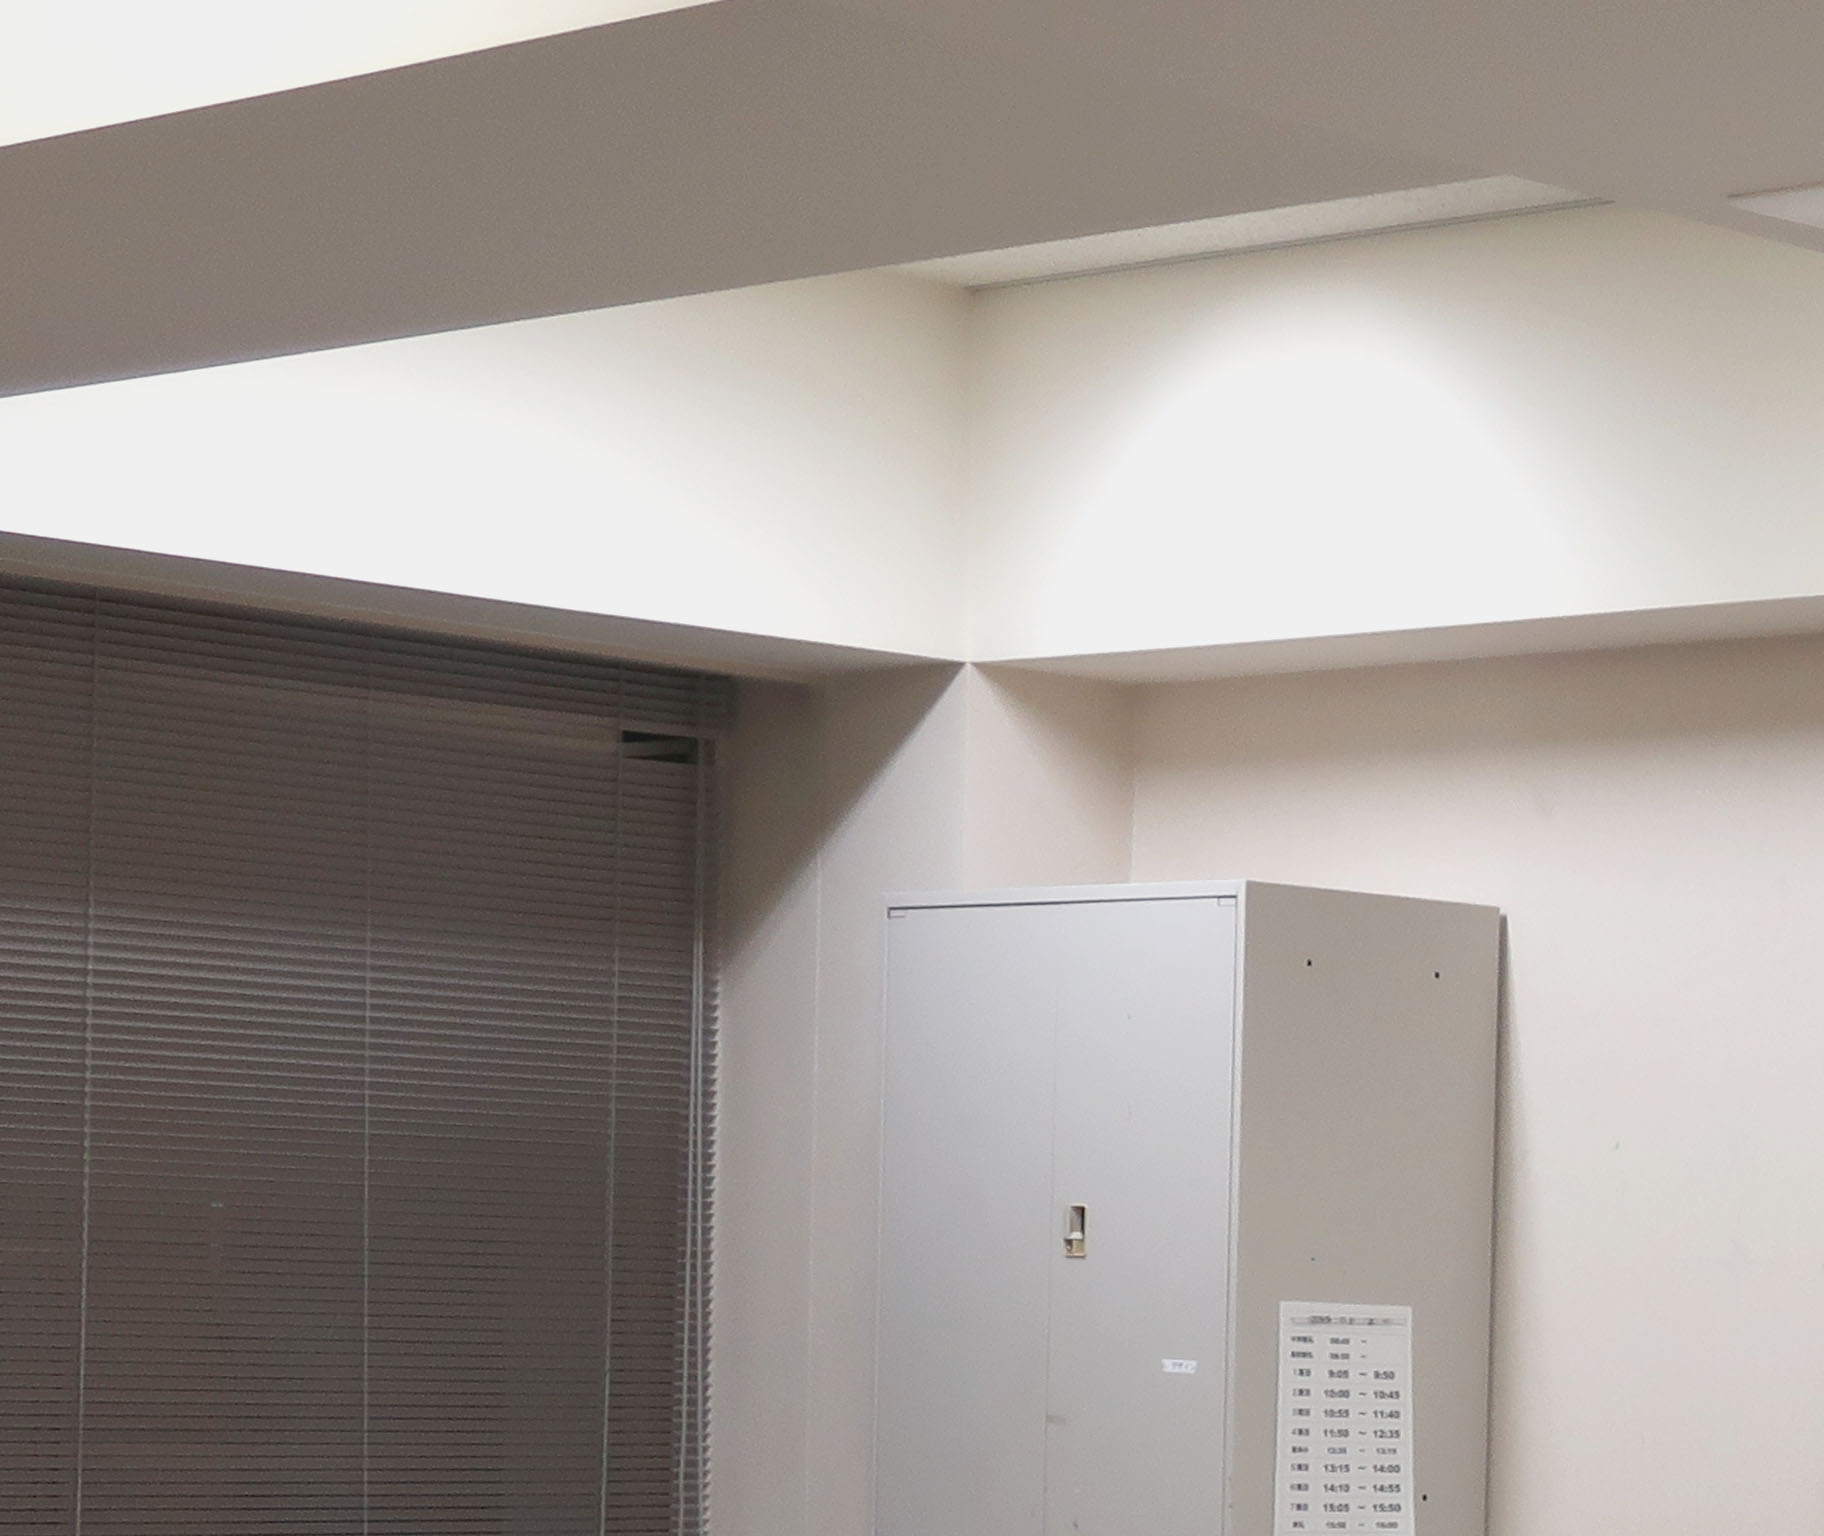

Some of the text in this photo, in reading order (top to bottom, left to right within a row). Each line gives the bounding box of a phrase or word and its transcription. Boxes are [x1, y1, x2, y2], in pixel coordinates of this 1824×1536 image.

[1372, 1389, 1401, 1401] 10:45
[1322, 1408, 1351, 1419] 10:55
[1372, 1409, 1401, 1420] 11:40
[1372, 1428, 1401, 1440] 12:35
[1322, 1463, 1351, 1474] 13:15
[1371, 1463, 1402, 1474] 14:00
[1322, 1483, 1351, 1494] 14:10
[1372, 1483, 1402, 1494] 14:55
[1322, 1502, 1351, 1513] 15:05
[1371, 1502, 1403, 1513] 15:50
